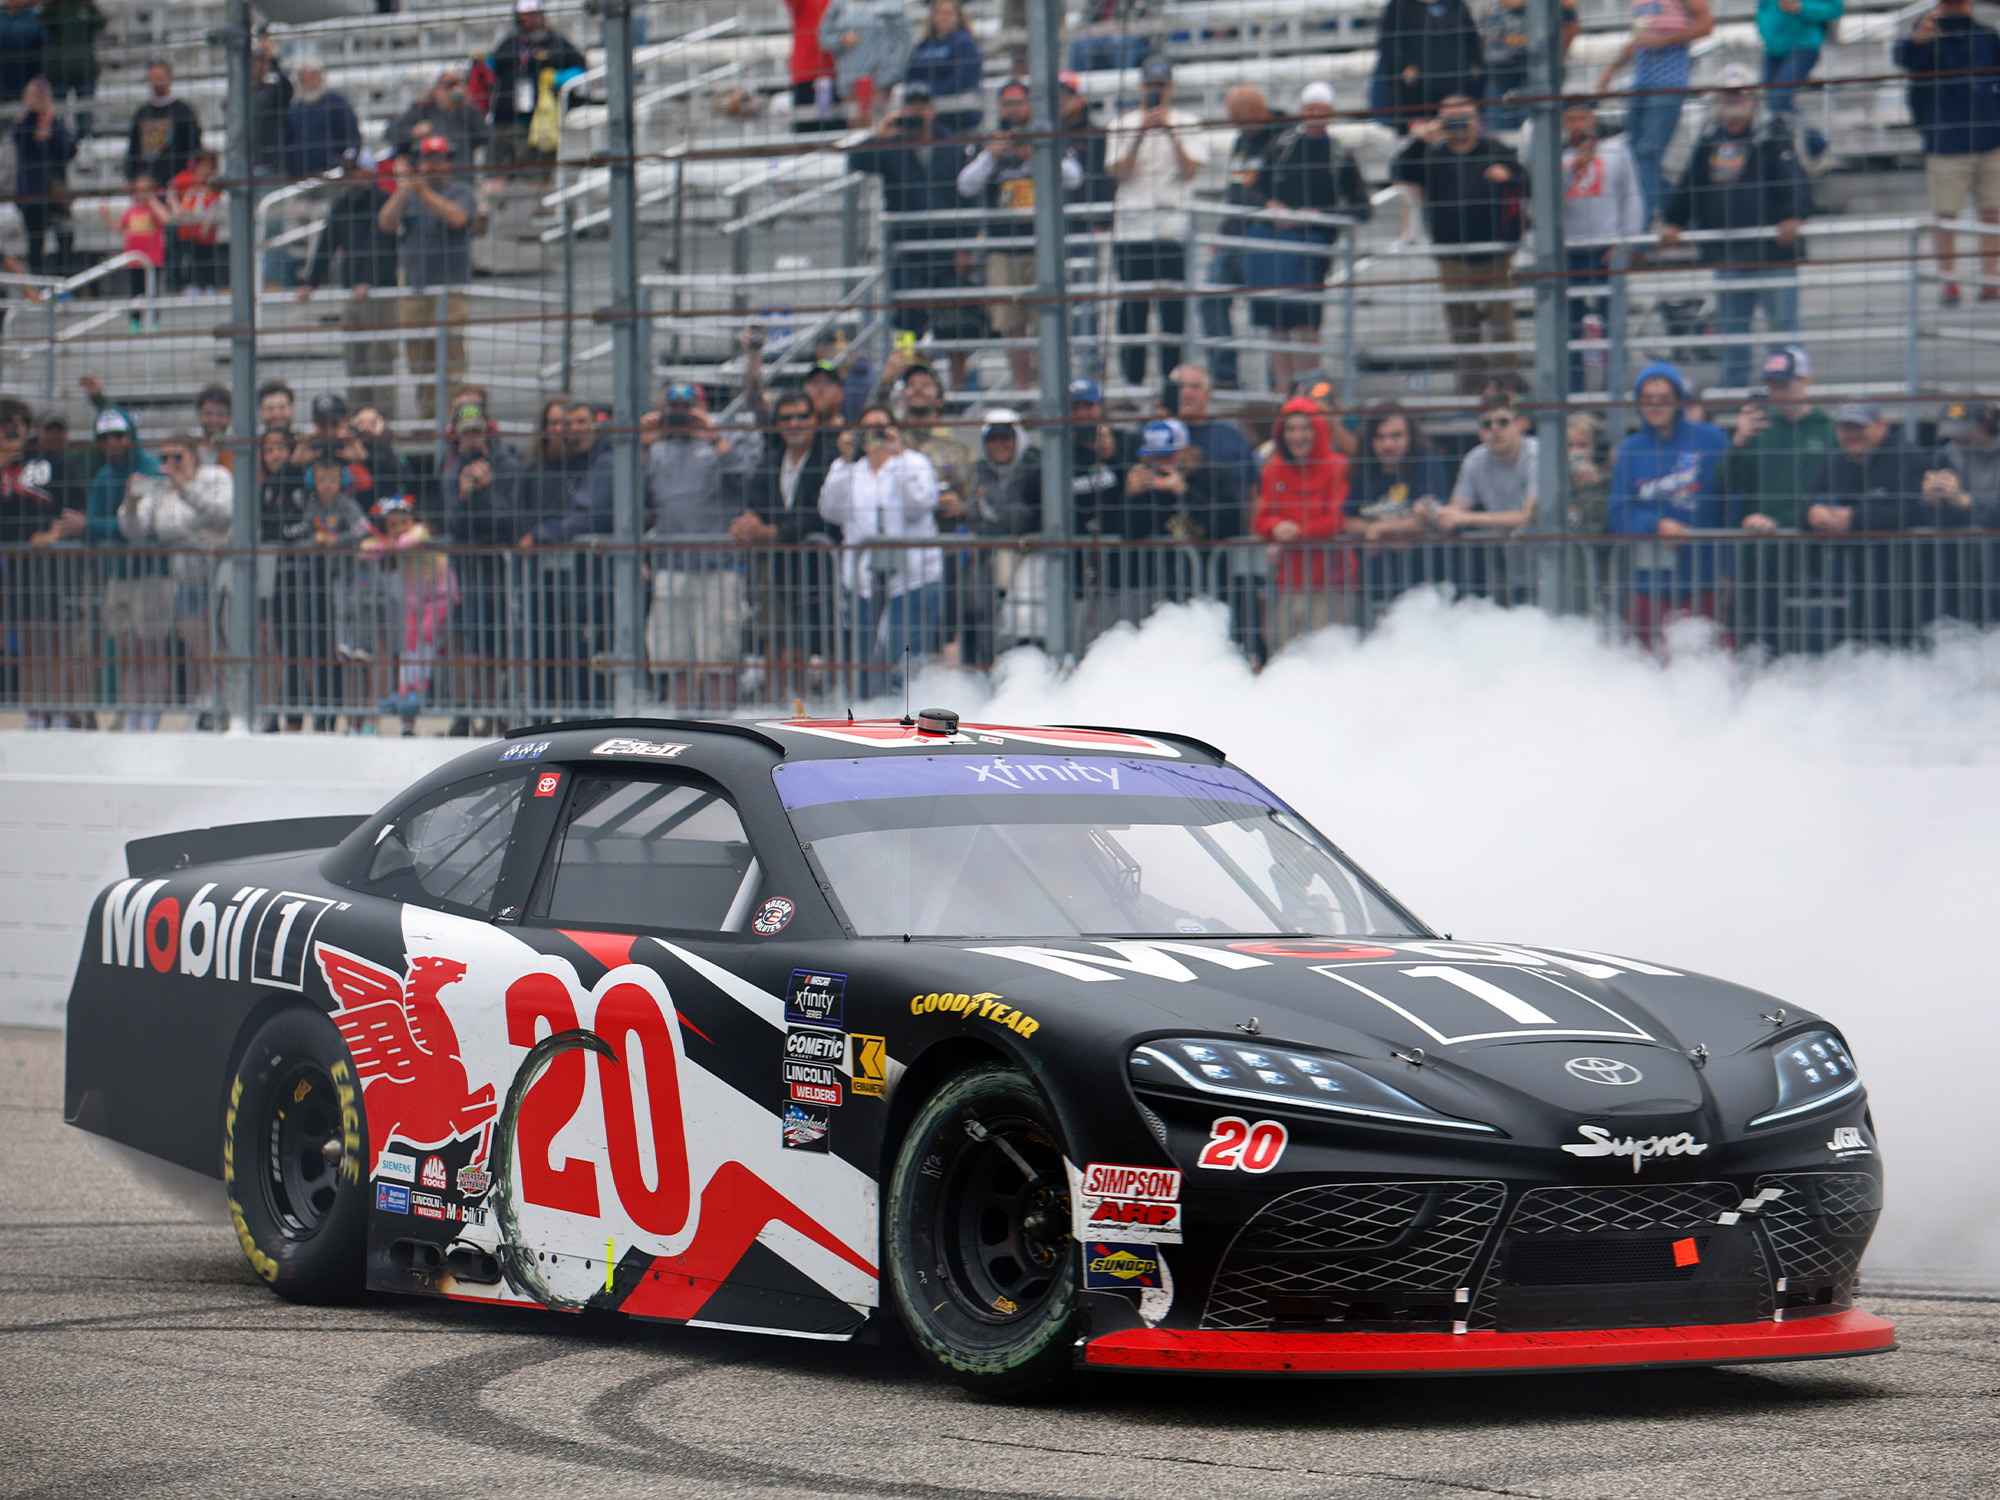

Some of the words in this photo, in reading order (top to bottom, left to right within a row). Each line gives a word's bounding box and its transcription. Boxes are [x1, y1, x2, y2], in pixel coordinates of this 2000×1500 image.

[965, 755, 1120, 790] xfinity
[102, 878, 270, 981] Mobil
[271, 901, 307, 977] 1
[794, 986, 834, 1015] xfinity
[1399, 966, 1558, 1024] 1
[911, 992, 1040, 1039] GOODYEAR
[787, 1035, 843, 1058] COMETIC
[786, 1065, 831, 1085] LINCOLN
[505, 972, 690, 1236] 20
[796, 1085, 836, 1102] WELDERS
[331, 1060, 360, 1184] EAGLE
[1198, 1117, 1288, 1173] 20
[1561, 1125, 1708, 1174] Supra
[382, 1160, 412, 1175] SIEMENS
[422, 1158, 447, 1180] MAC
[422, 1177, 447, 1190] TOOLS
[1089, 1168, 1174, 1197] SIMPSON
[412, 1194, 440, 1208] LINCOLN
[446, 1202, 476, 1223] Mobil
[1089, 1200, 1177, 1225] ARP
[1091, 1259, 1157, 1272] SUNOCO
